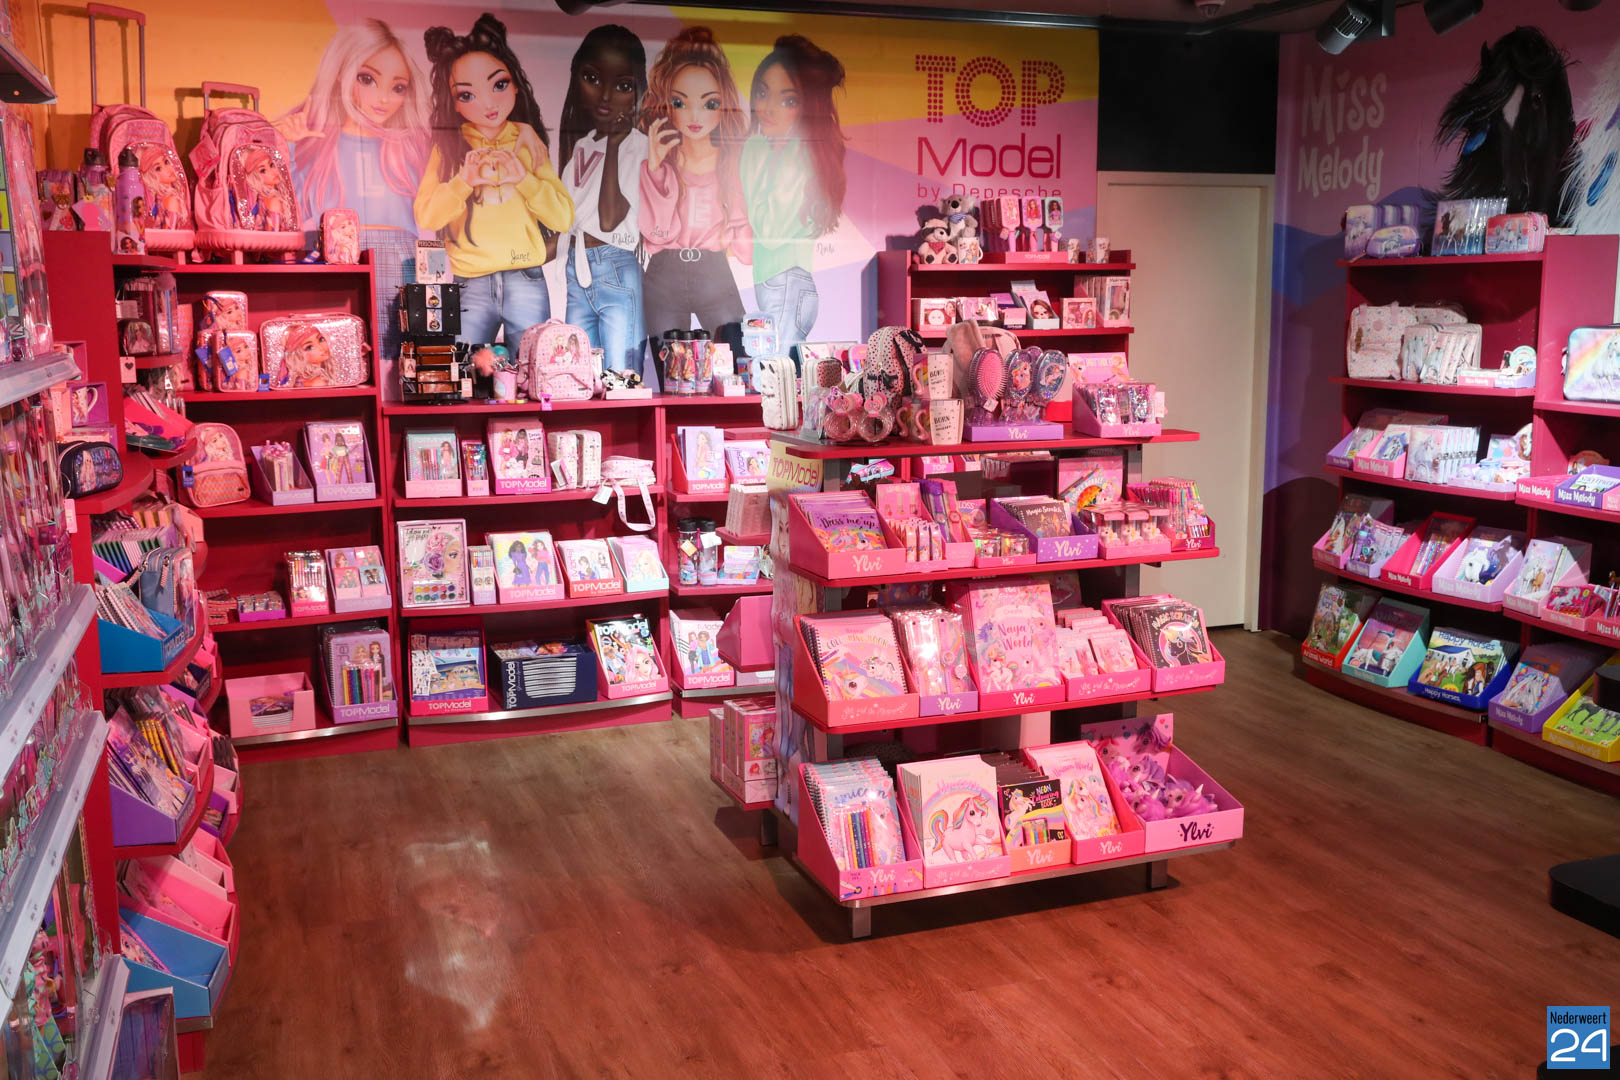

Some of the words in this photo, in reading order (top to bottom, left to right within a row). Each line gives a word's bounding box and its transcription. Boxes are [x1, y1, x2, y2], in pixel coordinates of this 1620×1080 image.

[915, 54, 1065, 127] TOP
[1301, 65, 1387, 144] Miss
[917, 132, 1061, 179] Model
[1298, 136, 1384, 201] Melody
[917, 183, 940, 200] by
[1008, 428, 1030, 440] Ylvi
[500, 479, 547, 490] TOPModel
[1518, 483, 1531, 495] Miss
[1531, 485, 1551, 499] Melody
[1557, 488, 1573, 501] Miss
[1573, 491, 1596, 507] Melody
[820, 516, 845, 529] Dress
[1054, 540, 1082, 558] Ylvi
[852, 554, 882, 573] Ylvi
[573, 580, 621, 593] TOPModel
[1438, 630, 1465, 647] Happy
[1467, 637, 1496, 651] Horses
[938, 698, 962, 711] Ylvi
[1013, 692, 1035, 705] Ylvi
[1178, 821, 1214, 843] Ylvi
[1099, 840, 1124, 855] Ylvi
[1026, 849, 1054, 866] Ylvi
[869, 869, 896, 885] Ylvi
